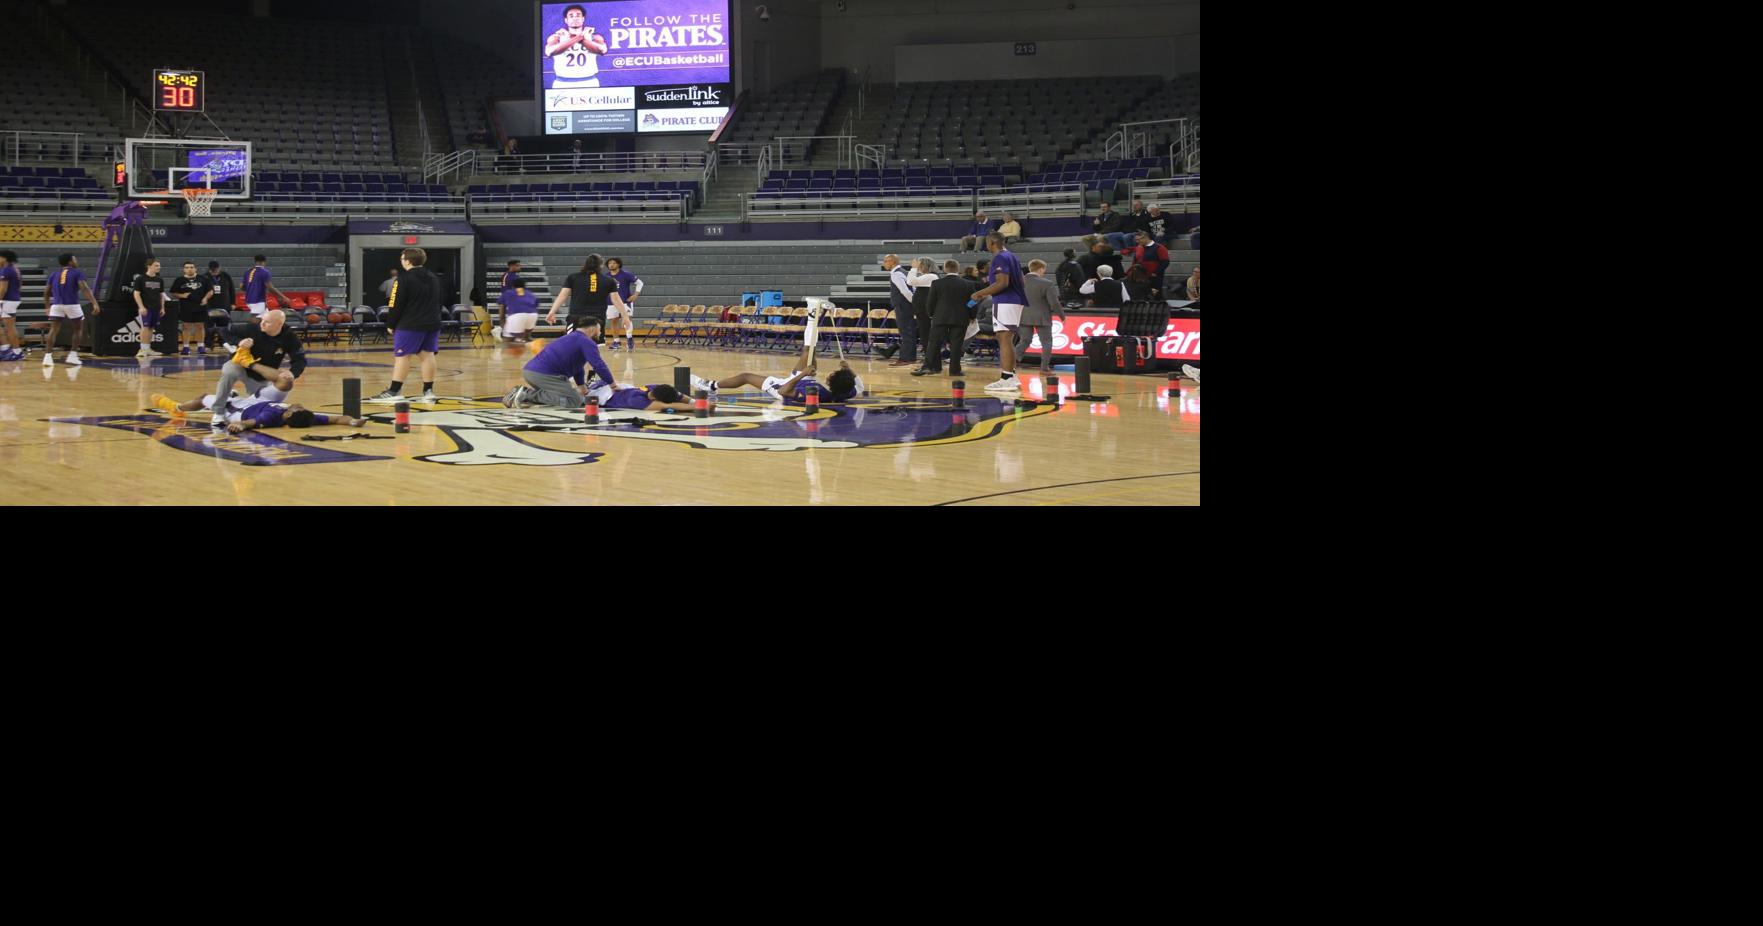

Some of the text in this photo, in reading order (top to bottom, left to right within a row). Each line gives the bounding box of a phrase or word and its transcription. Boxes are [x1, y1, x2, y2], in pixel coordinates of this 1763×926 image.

[610, 13, 722, 27] FOLLOW THE
[609, 24, 724, 50] PIRATES
[1016, 45, 1034, 54] 213
[566, 52, 587, 67] 20
[612, 53, 724, 68] @ECUBasketball
[158, 74, 198, 87] 42:42
[163, 86, 194, 107] 30
[588, 95, 632, 104] Cellular
[645, 85, 721, 101] suddenlink
[661, 116, 697, 126] PIRATE
[150, 228, 166, 236] 110
